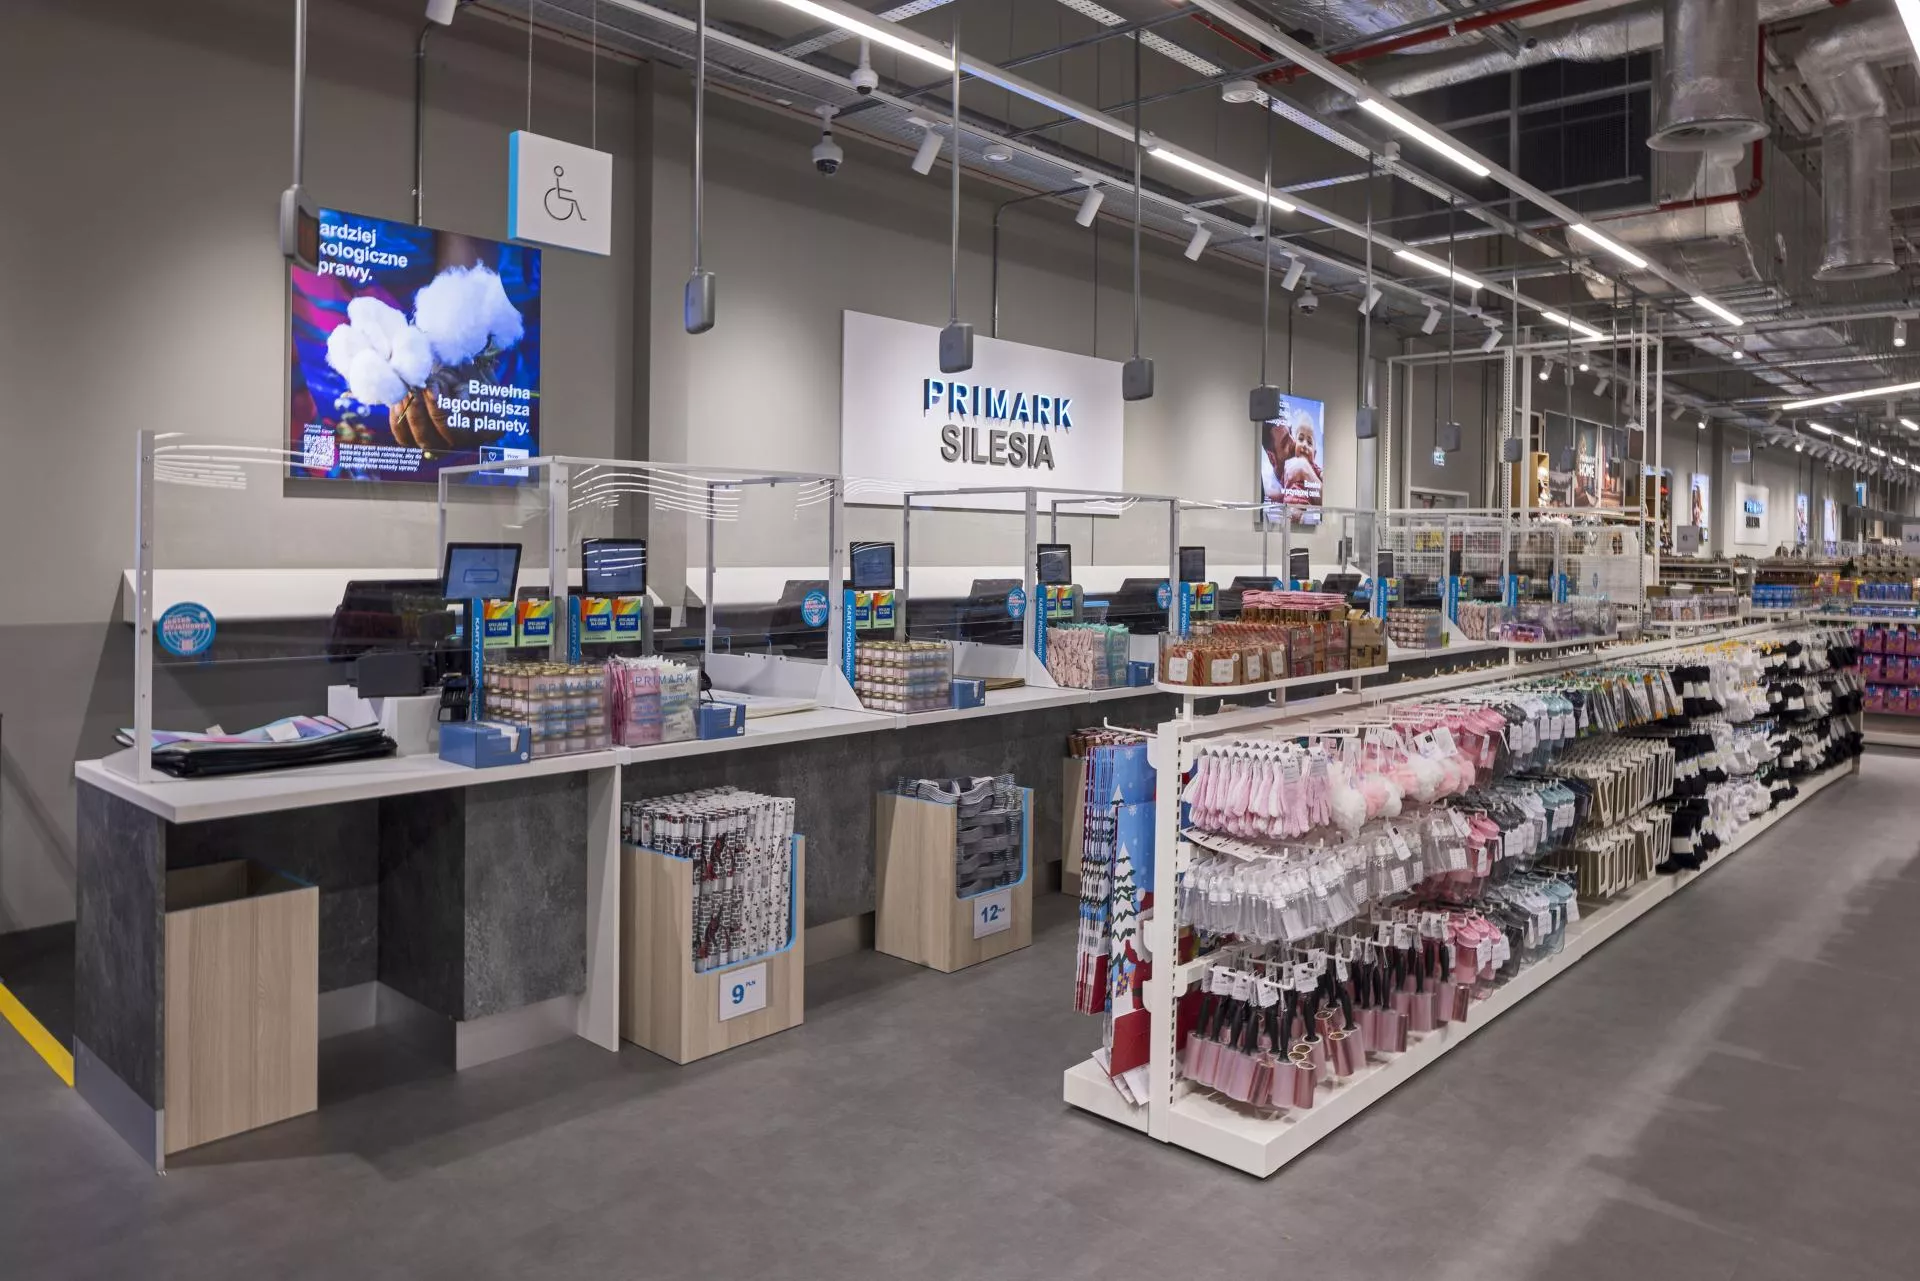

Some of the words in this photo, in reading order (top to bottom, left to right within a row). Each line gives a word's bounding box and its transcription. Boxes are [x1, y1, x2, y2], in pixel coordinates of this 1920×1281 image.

[320, 223, 377, 248] ardziej
[317, 260, 373, 283] prawy.
[469, 379, 531, 399] Bawełna
[437, 394, 530, 417] łagodniejsza
[923, 378, 1073, 429] PRIMARK
[447, 413, 470, 428] dla
[474, 416, 530, 436] planety.
[940, 423, 1056, 471] SILESIA
[1579, 463, 1595, 477] HOME
[635, 673, 692, 688] PRIMARK
[981, 904, 998, 923] 12
[732, 984, 745, 1004] 9
